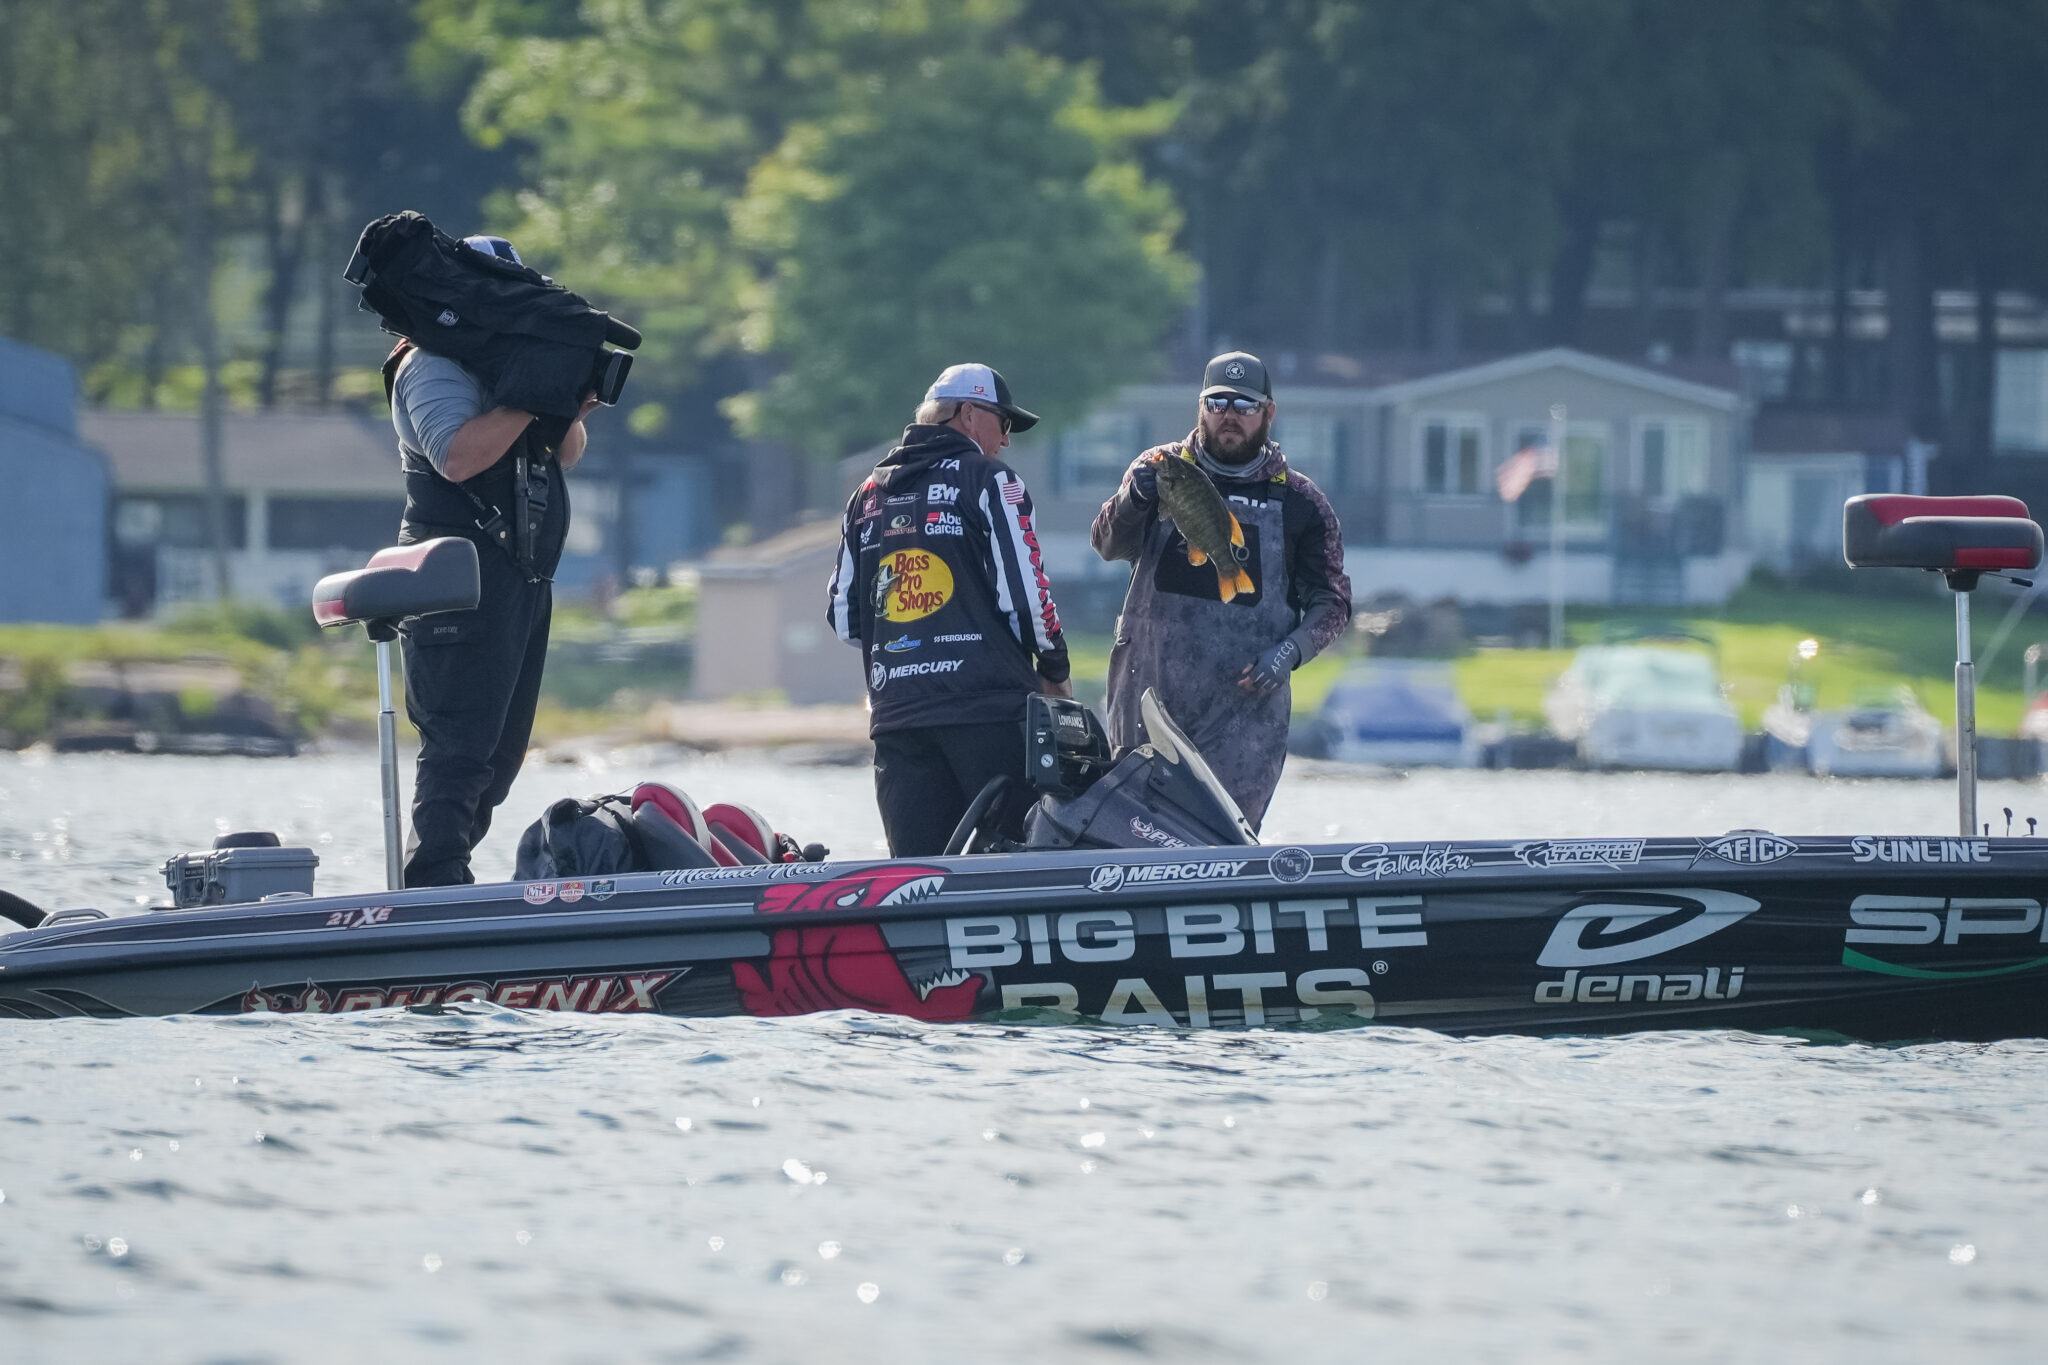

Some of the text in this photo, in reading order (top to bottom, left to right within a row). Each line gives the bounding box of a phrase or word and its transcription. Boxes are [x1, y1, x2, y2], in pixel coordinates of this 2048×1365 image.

[924, 523, 963, 536] Garcia
[939, 512, 962, 525] Abu
[894, 552, 930, 575] Bass
[896, 572, 922, 593] Pro
[897, 590, 944, 613] Shops
[941, 633, 982, 643] FERGUSON
[1271, 640, 1295, 675] AFTCO
[889, 660, 964, 680] MERCURY
[1058, 714, 1084, 729] LOWRANCE
[1147, 829, 1189, 848] PH
[1716, 836, 1789, 862] AFTCO
[1850, 835, 1992, 863] SUNLINE
[1341, 843, 1469, 881] Gamakatsu
[1554, 850, 1633, 862] TACKLE
[658, 862, 833, 885] Michael Neal
[1126, 861, 1248, 882] MERCURY
[528, 885, 553, 897] MLF
[1844, 894, 2048, 945] SP
[945, 895, 1428, 968] BIG BITE
[1534, 966, 1745, 1003] denali
[1001, 968, 1376, 1028] BAITS
